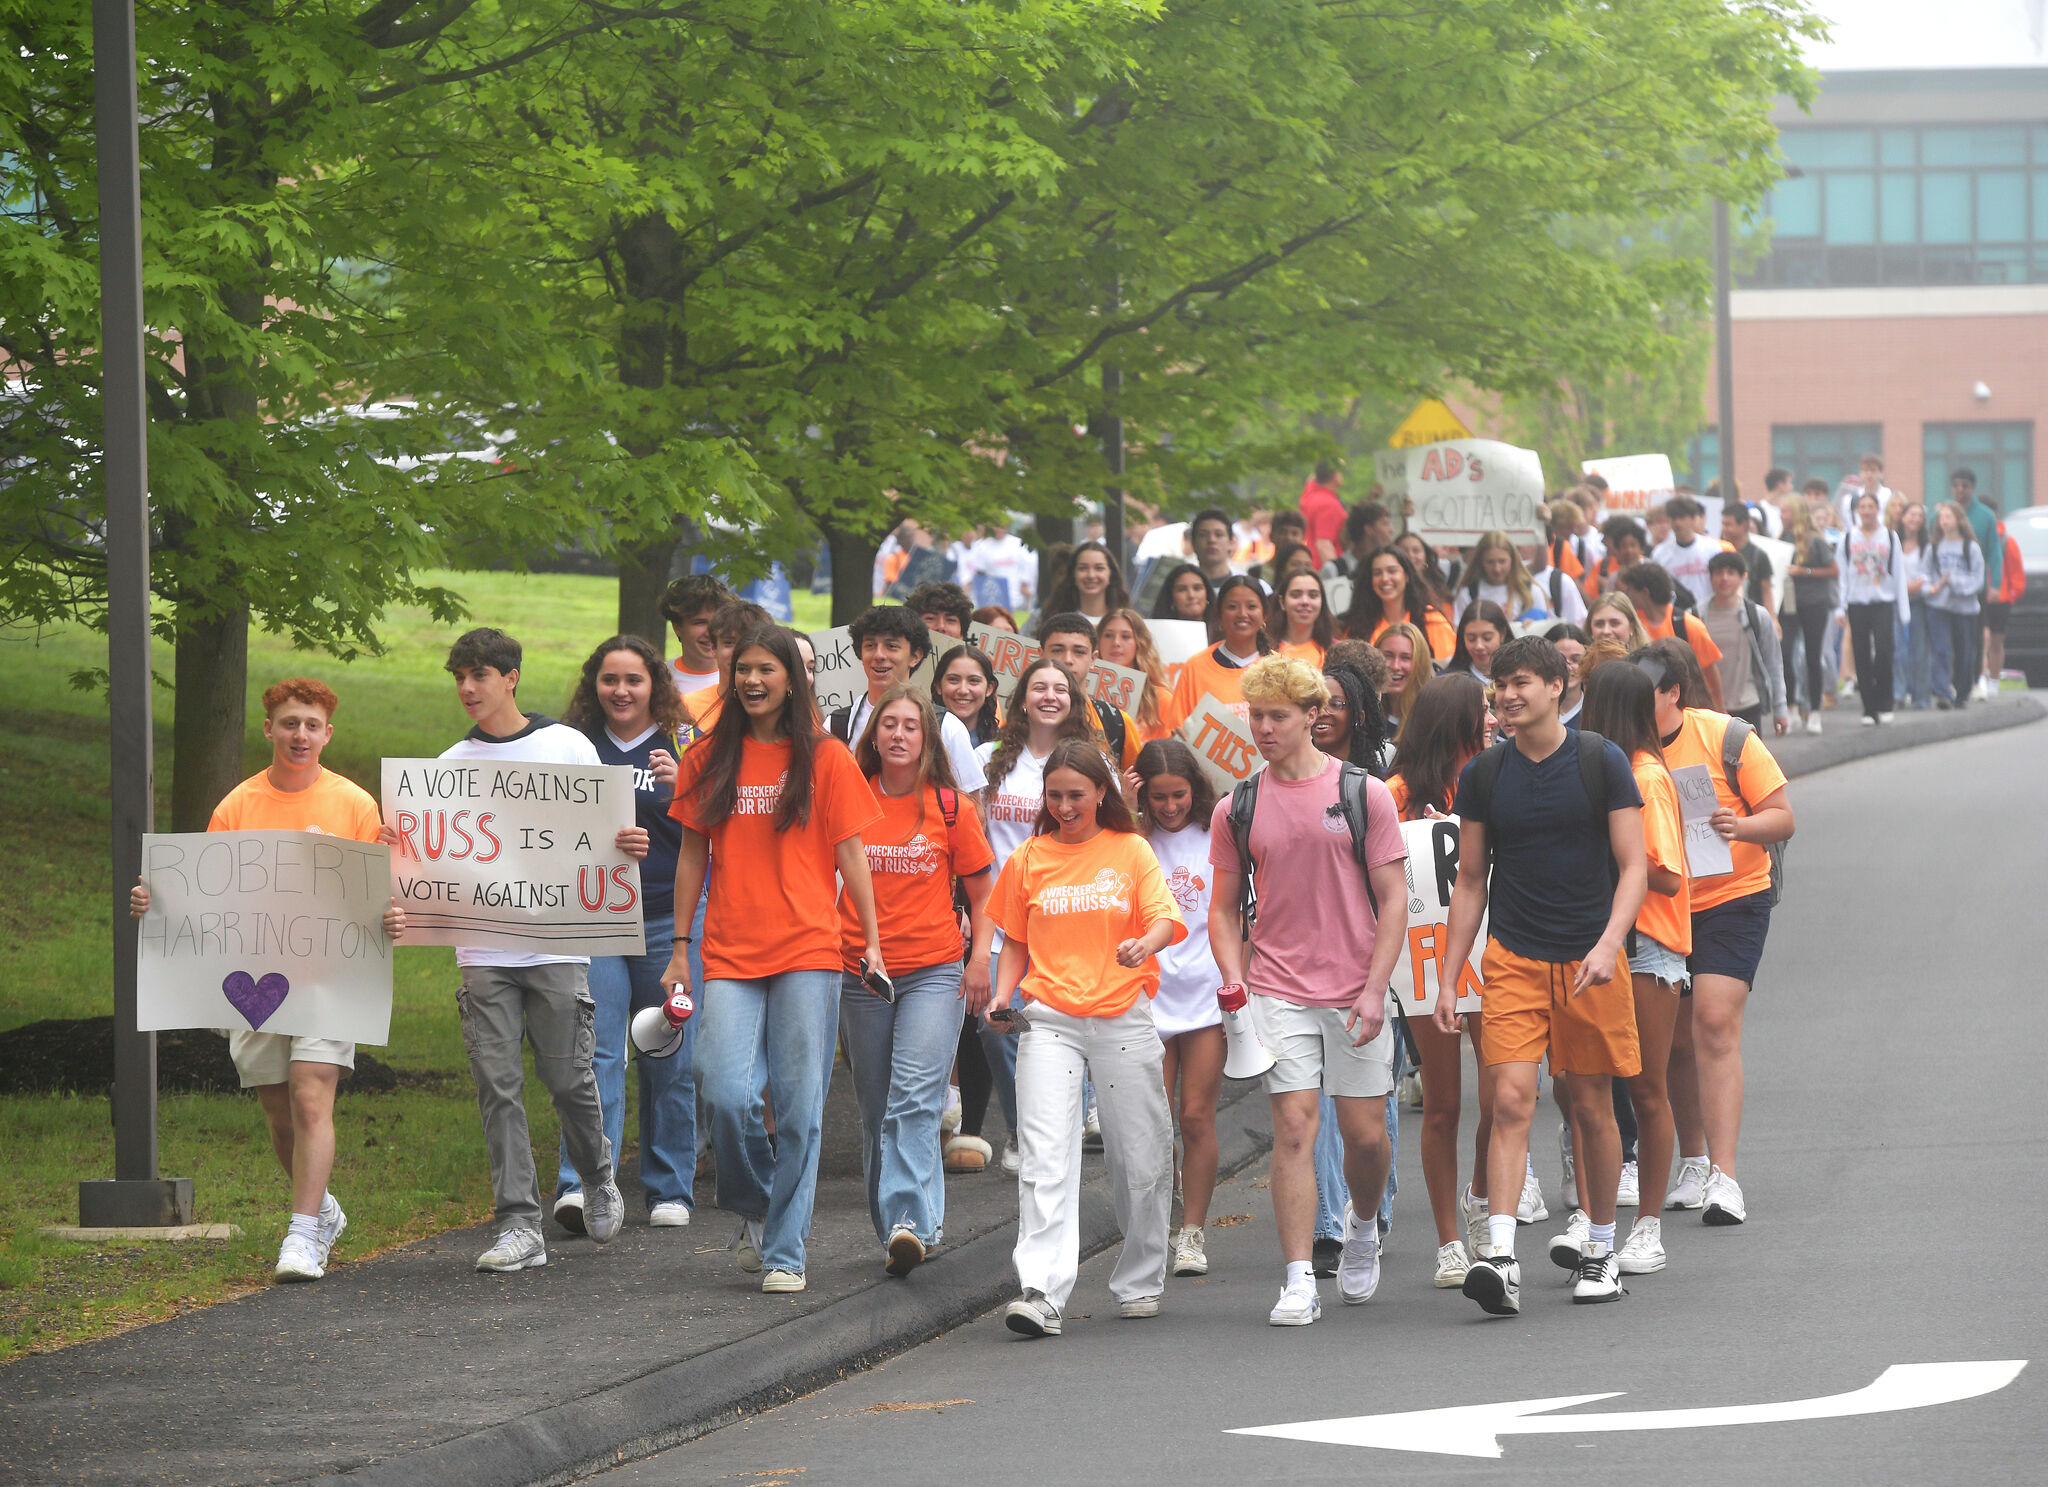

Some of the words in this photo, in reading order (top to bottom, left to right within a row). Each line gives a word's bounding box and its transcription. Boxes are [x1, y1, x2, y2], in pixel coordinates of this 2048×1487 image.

[1421, 448, 1485, 481] AD's
[1423, 495, 1497, 529] GOTTA
[1503, 493, 1534, 528] GO
[1193, 712, 1257, 780] THIS
[397, 770, 414, 797] A
[424, 769, 481, 799] VOTE
[491, 770, 605, 805] AGAINST
[990, 804, 1012, 822] FOR
[396, 810, 502, 864] RUSS
[520, 828, 555, 850] IS
[575, 831, 592, 851] A
[148, 840, 385, 900] ROBERT
[885, 858, 918, 875] RUSS
[398, 876, 460, 903] VOTE
[472, 880, 570, 909] AGAINST
[577, 864, 639, 914] US
[1038, 883, 1097, 901] #WRECKERS
[1042, 898, 1069, 916] FOR
[1071, 894, 1108, 913] RUSS
[141, 911, 386, 960] HARRINGTON
